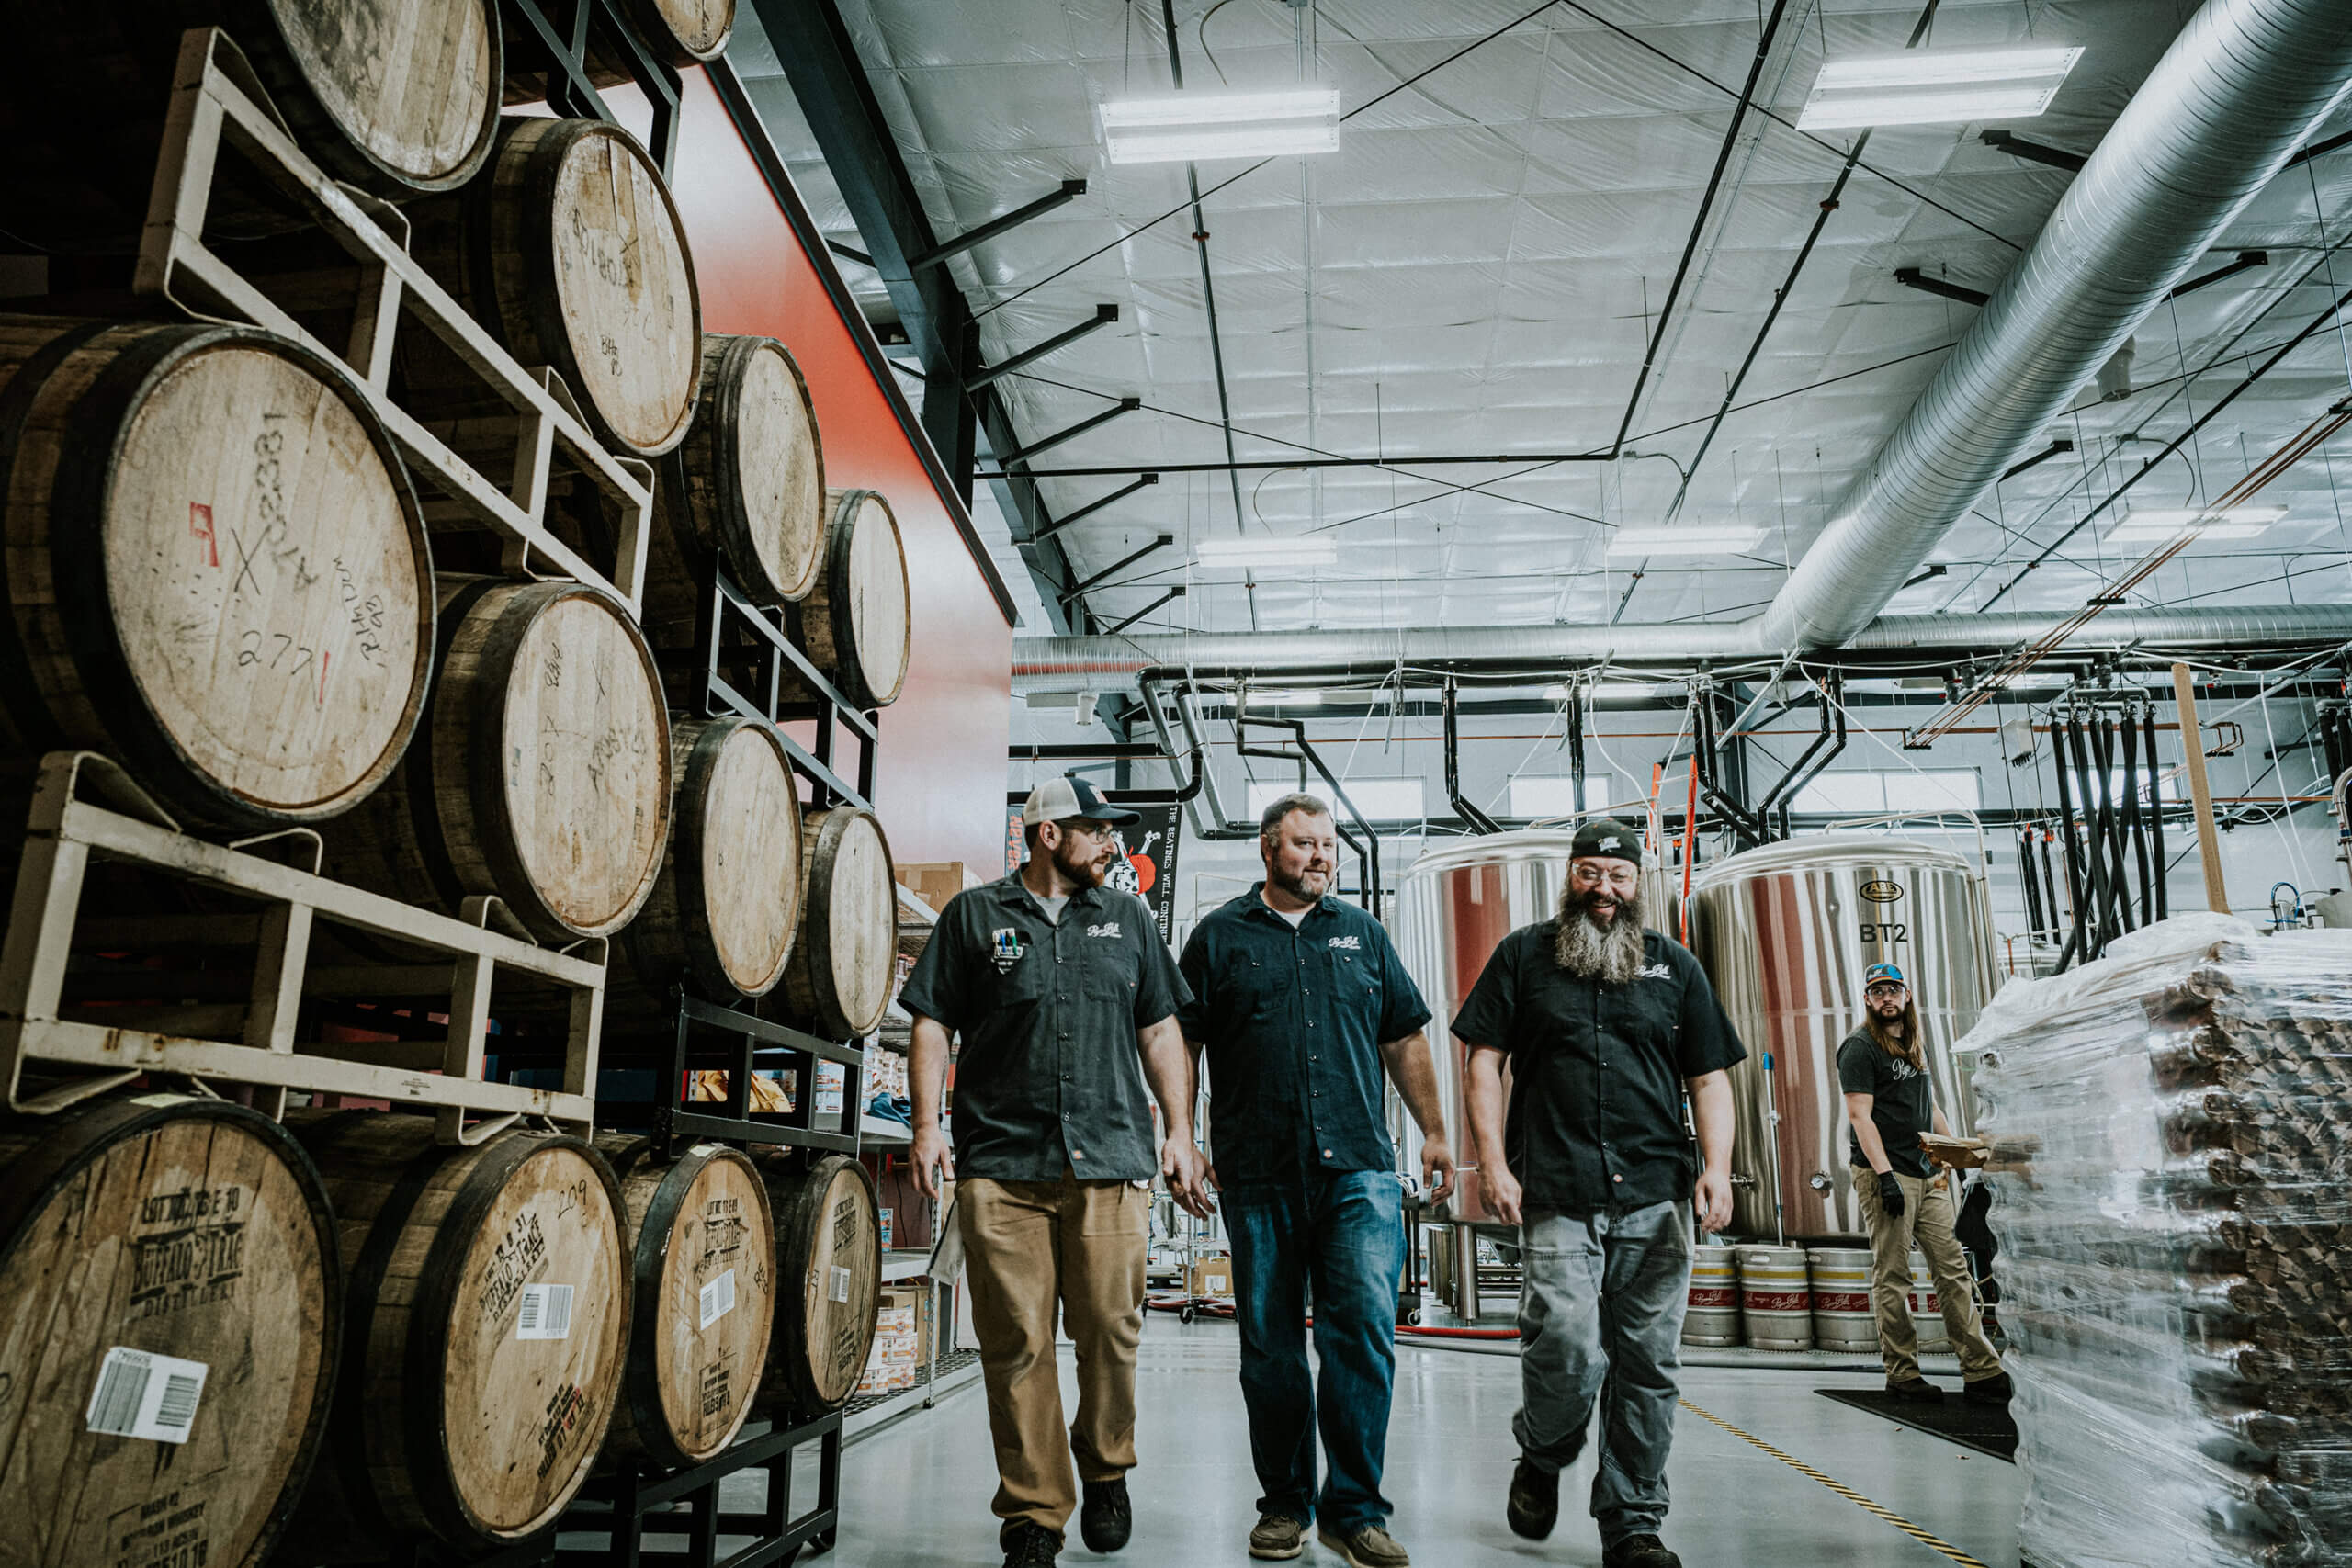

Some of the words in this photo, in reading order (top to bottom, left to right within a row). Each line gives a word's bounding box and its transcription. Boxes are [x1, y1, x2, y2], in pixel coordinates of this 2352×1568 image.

[1168, 806, 1178, 824] THE
[1163, 827, 1176, 870] BEATINGS
[1161, 873, 1171, 897] WILL
[1868, 882, 1895, 893] ABE
[1860, 923, 1908, 942] BT2
[558, 1179, 588, 1220] 209
